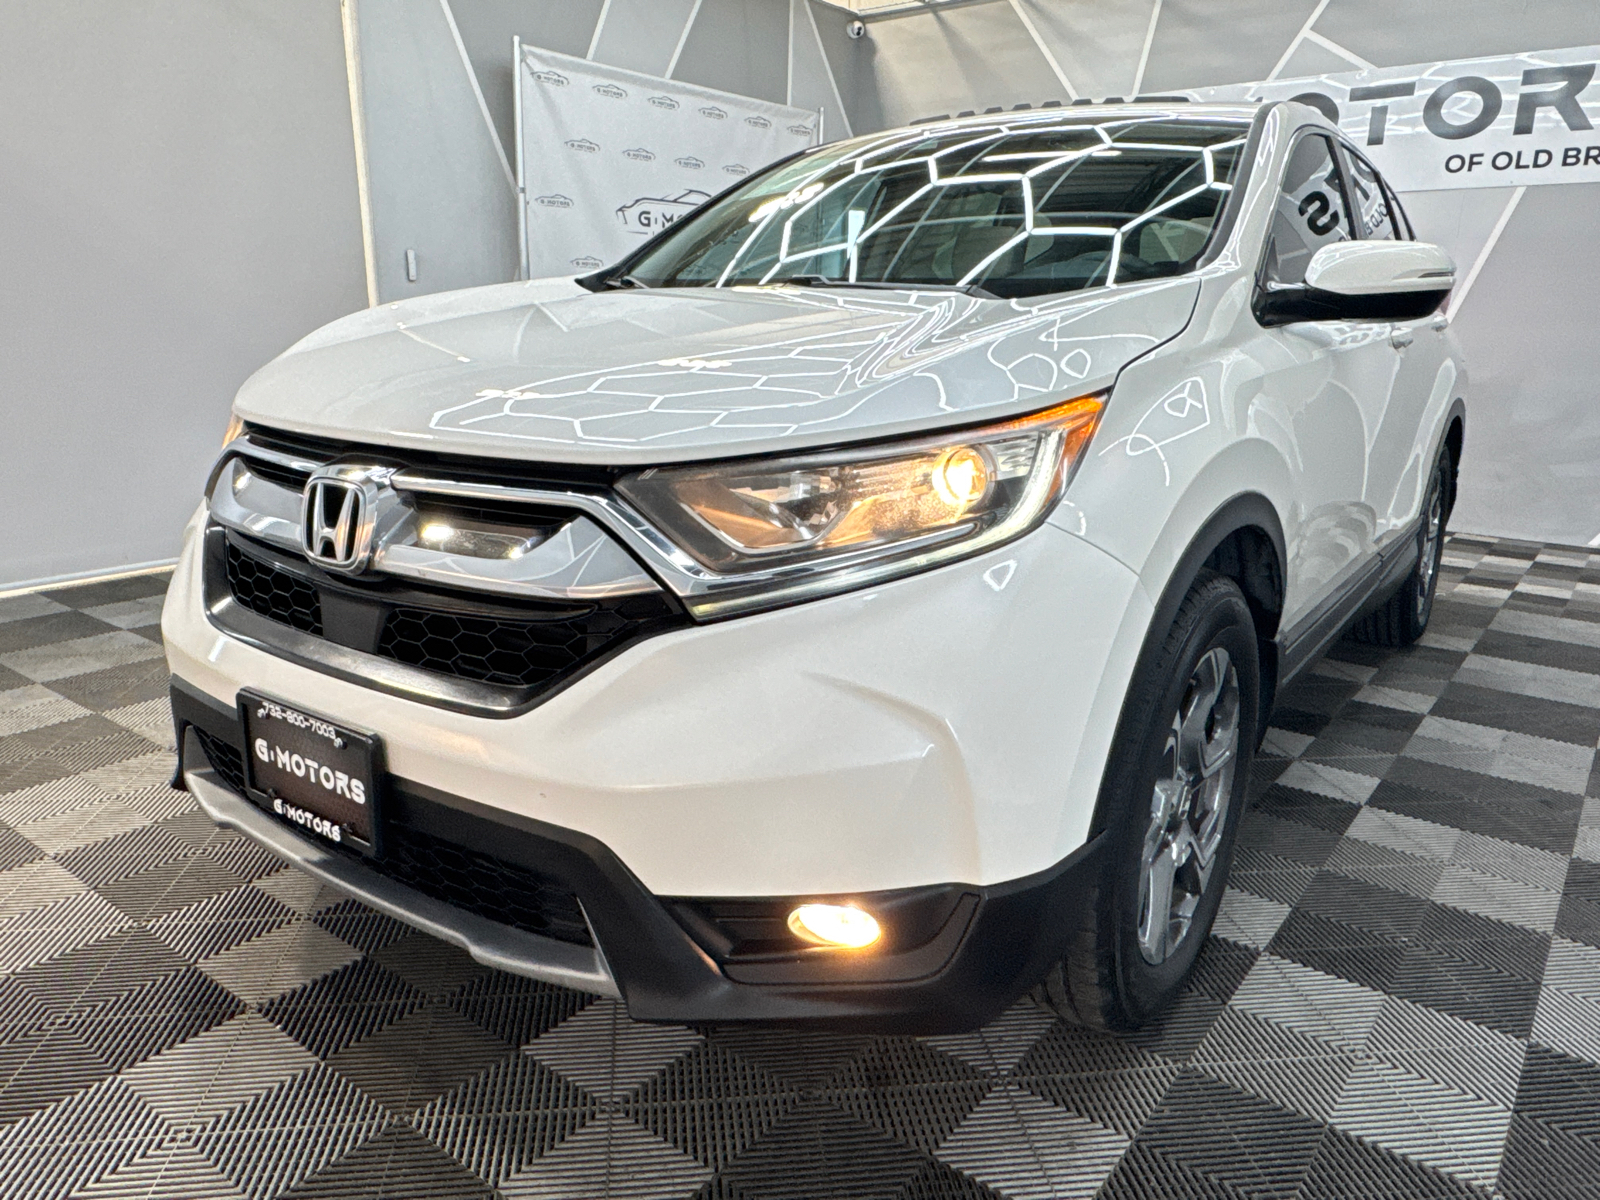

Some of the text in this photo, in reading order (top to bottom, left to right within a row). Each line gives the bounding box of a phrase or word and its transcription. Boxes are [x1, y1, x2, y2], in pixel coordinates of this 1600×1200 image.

[1444, 152, 1485, 174] OF
[1491, 148, 1553, 171] OLD
[262, 701, 336, 740] 732-800-7003
